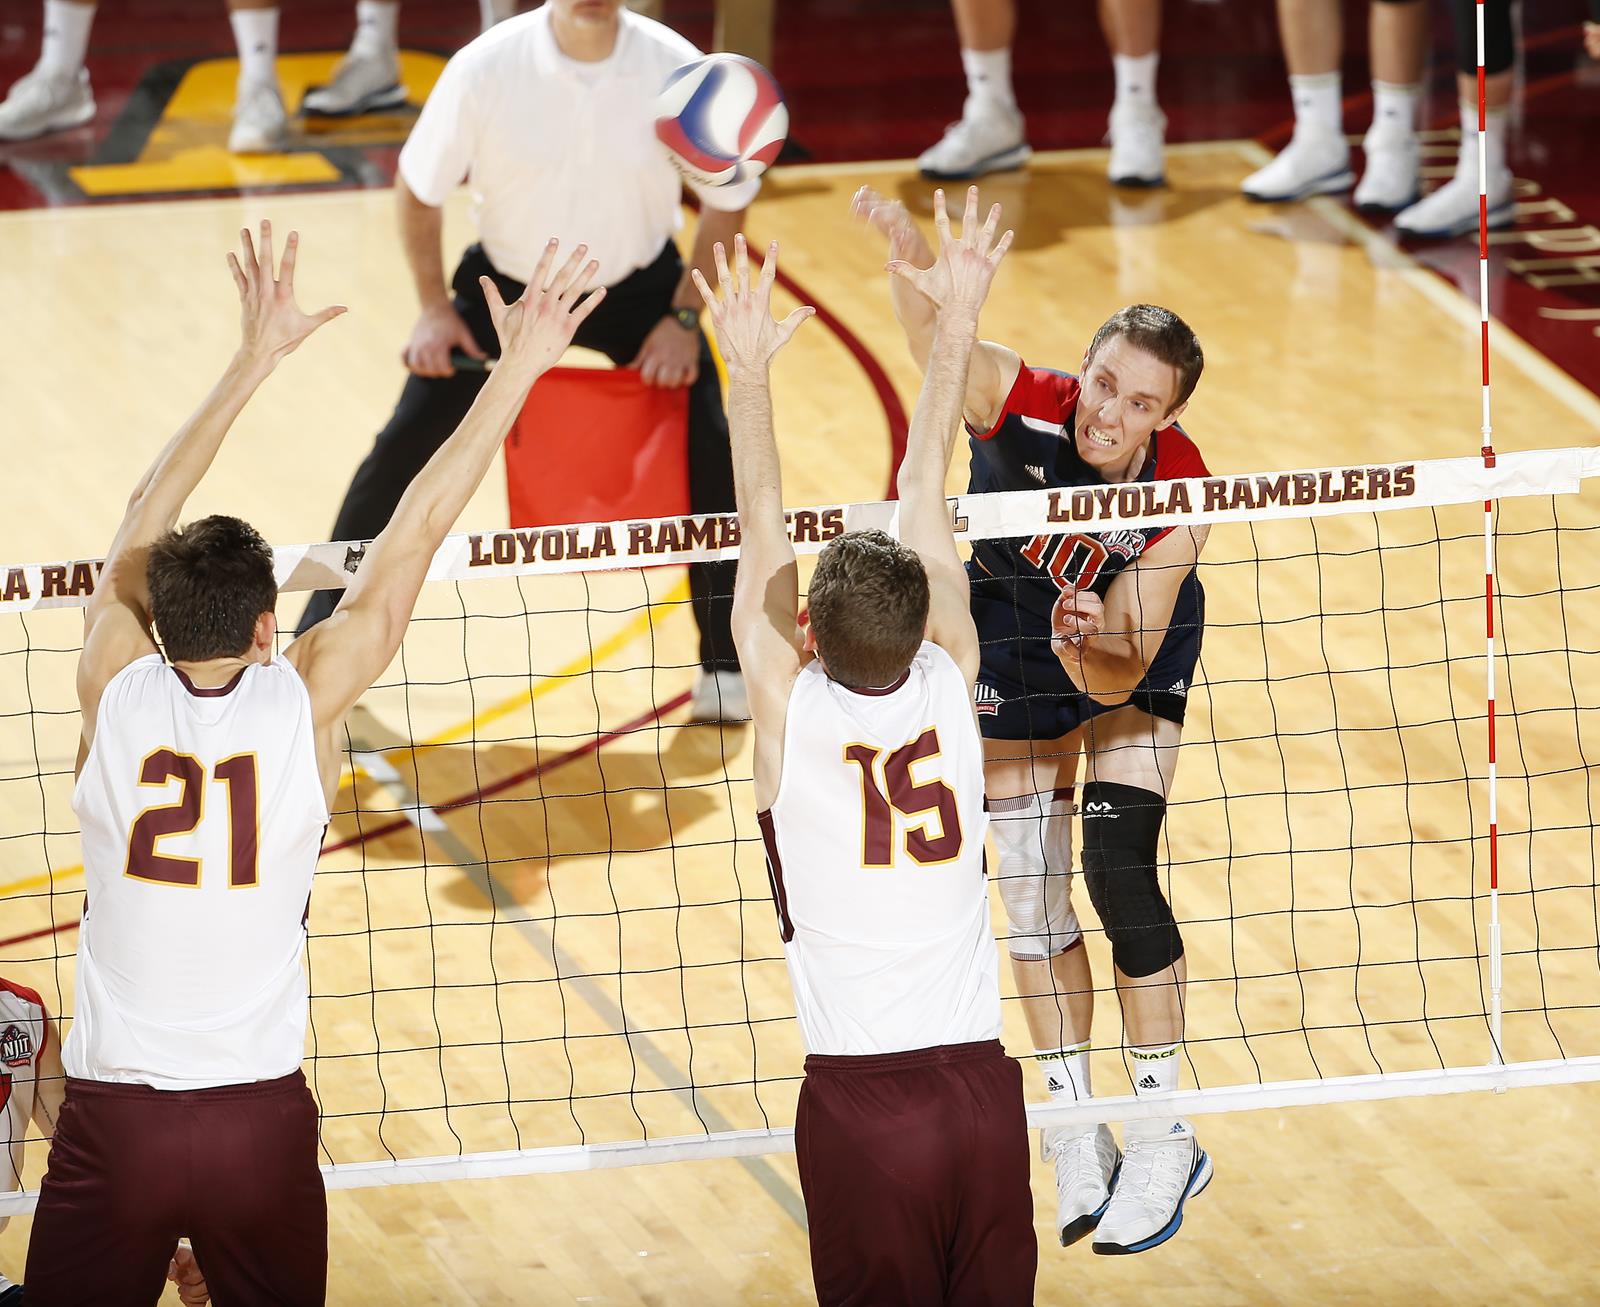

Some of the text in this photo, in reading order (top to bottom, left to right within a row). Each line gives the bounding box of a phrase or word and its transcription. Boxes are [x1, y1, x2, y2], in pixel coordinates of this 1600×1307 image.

[1046, 465, 1416, 523] LOYOLA RAMBLERS
[468, 508, 845, 567] LOYOLA RAMBRS
[1019, 533, 1109, 592] 10
[0, 568, 30, 601] A
[123, 745, 261, 890] 21
[842, 725, 965, 869] 15
[1036, 1050, 1078, 1061] ENACE
